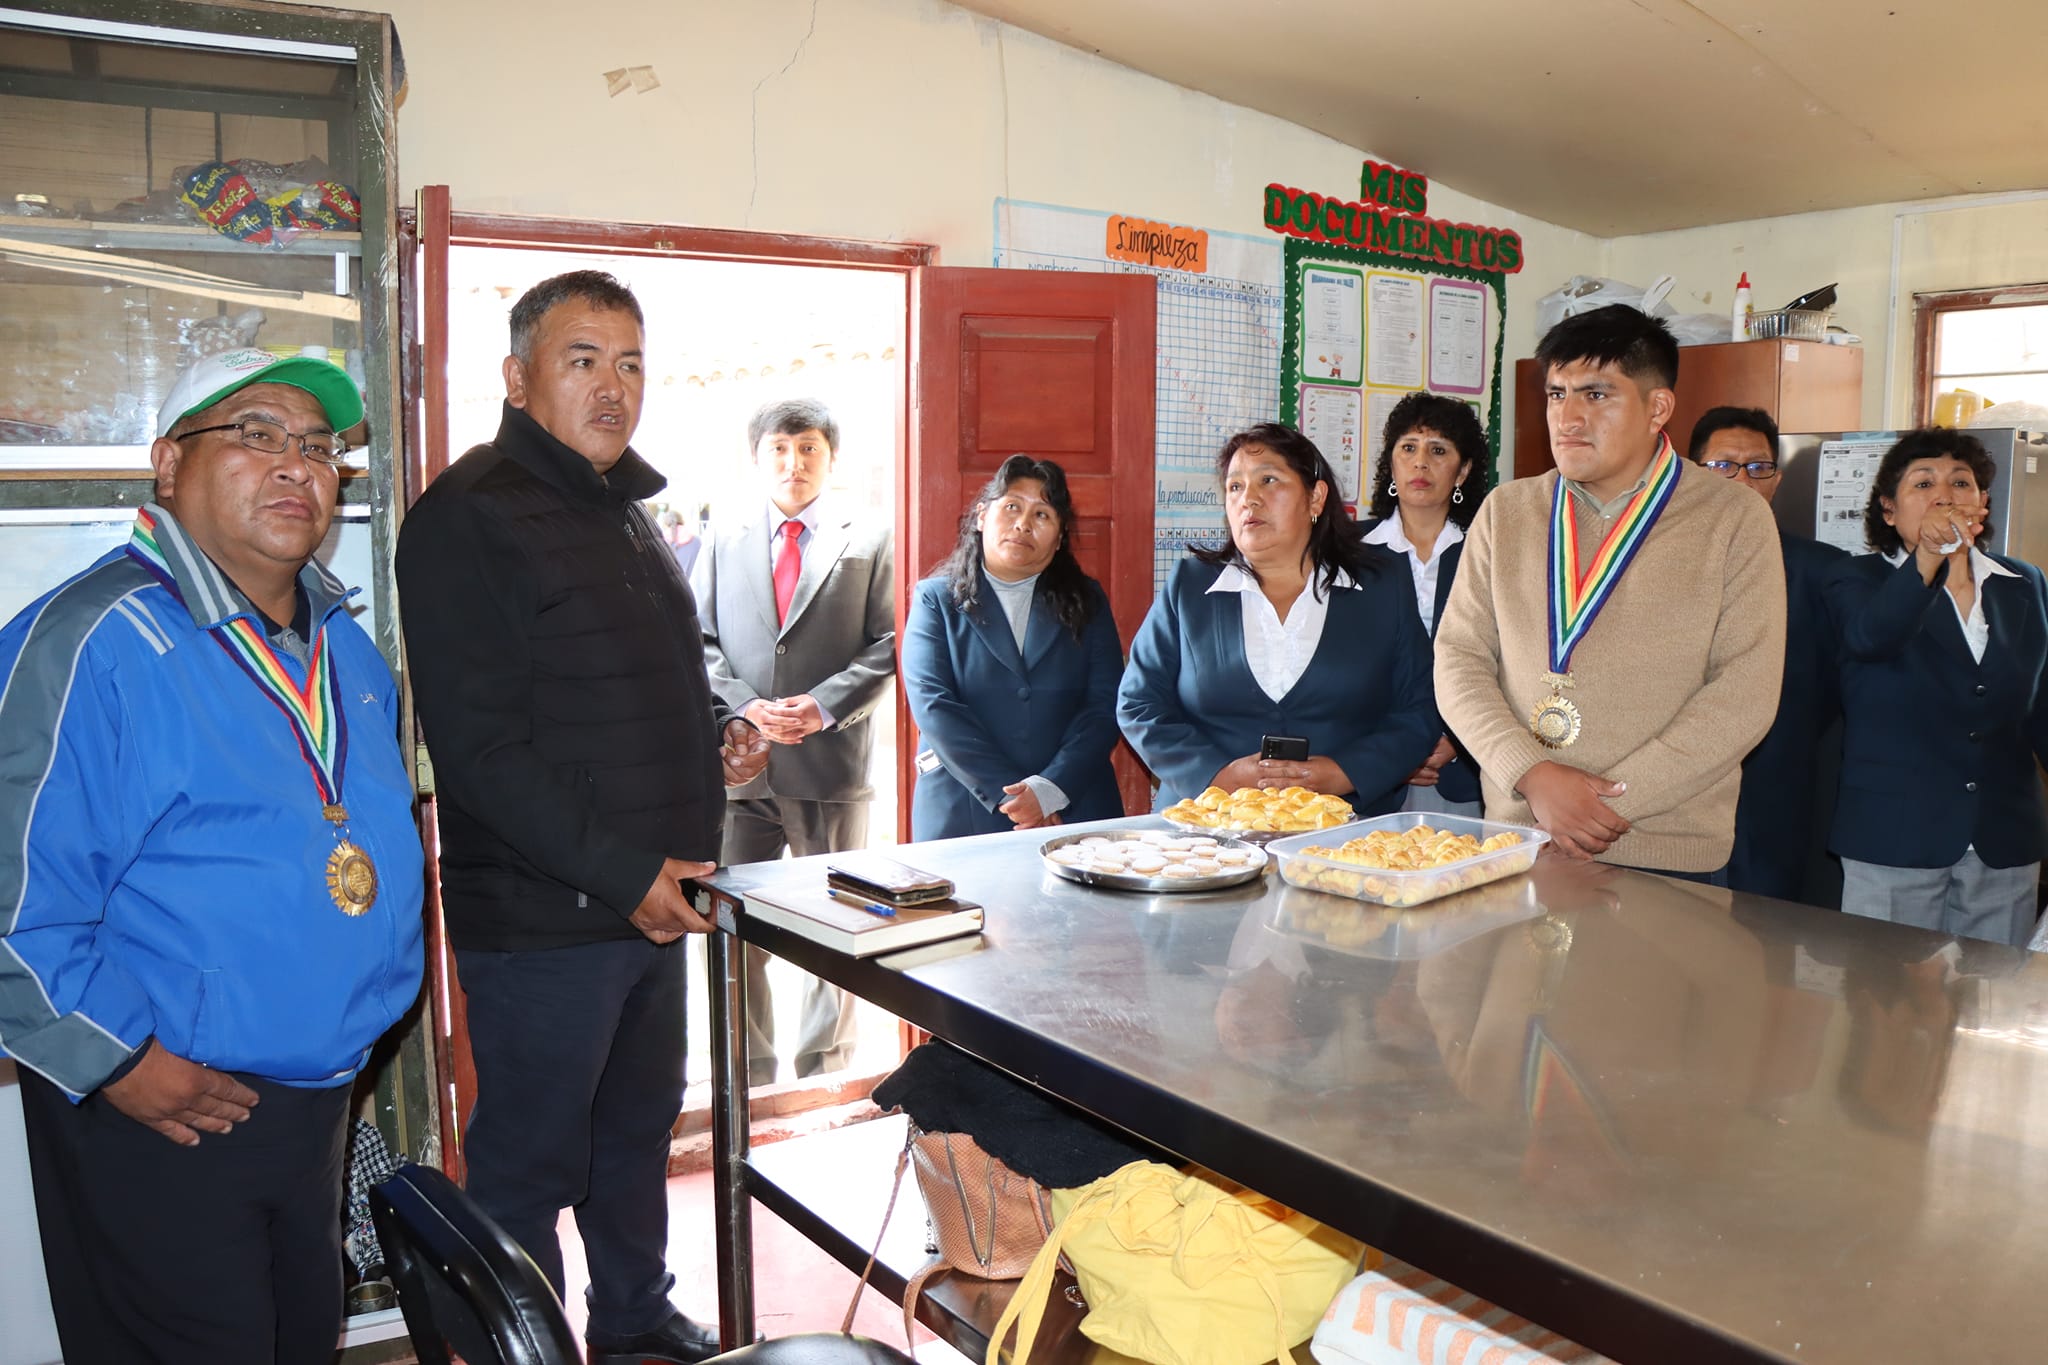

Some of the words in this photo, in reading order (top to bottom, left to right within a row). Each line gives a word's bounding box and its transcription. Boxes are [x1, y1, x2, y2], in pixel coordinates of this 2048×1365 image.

[207, 185, 250, 219] Fiesta
[1361, 164, 1425, 213] MIS
[1116, 222, 1198, 268] Limpieza
[1265, 187, 1519, 269] DOCUMENTOS
[1167, 481, 1217, 509] producción
